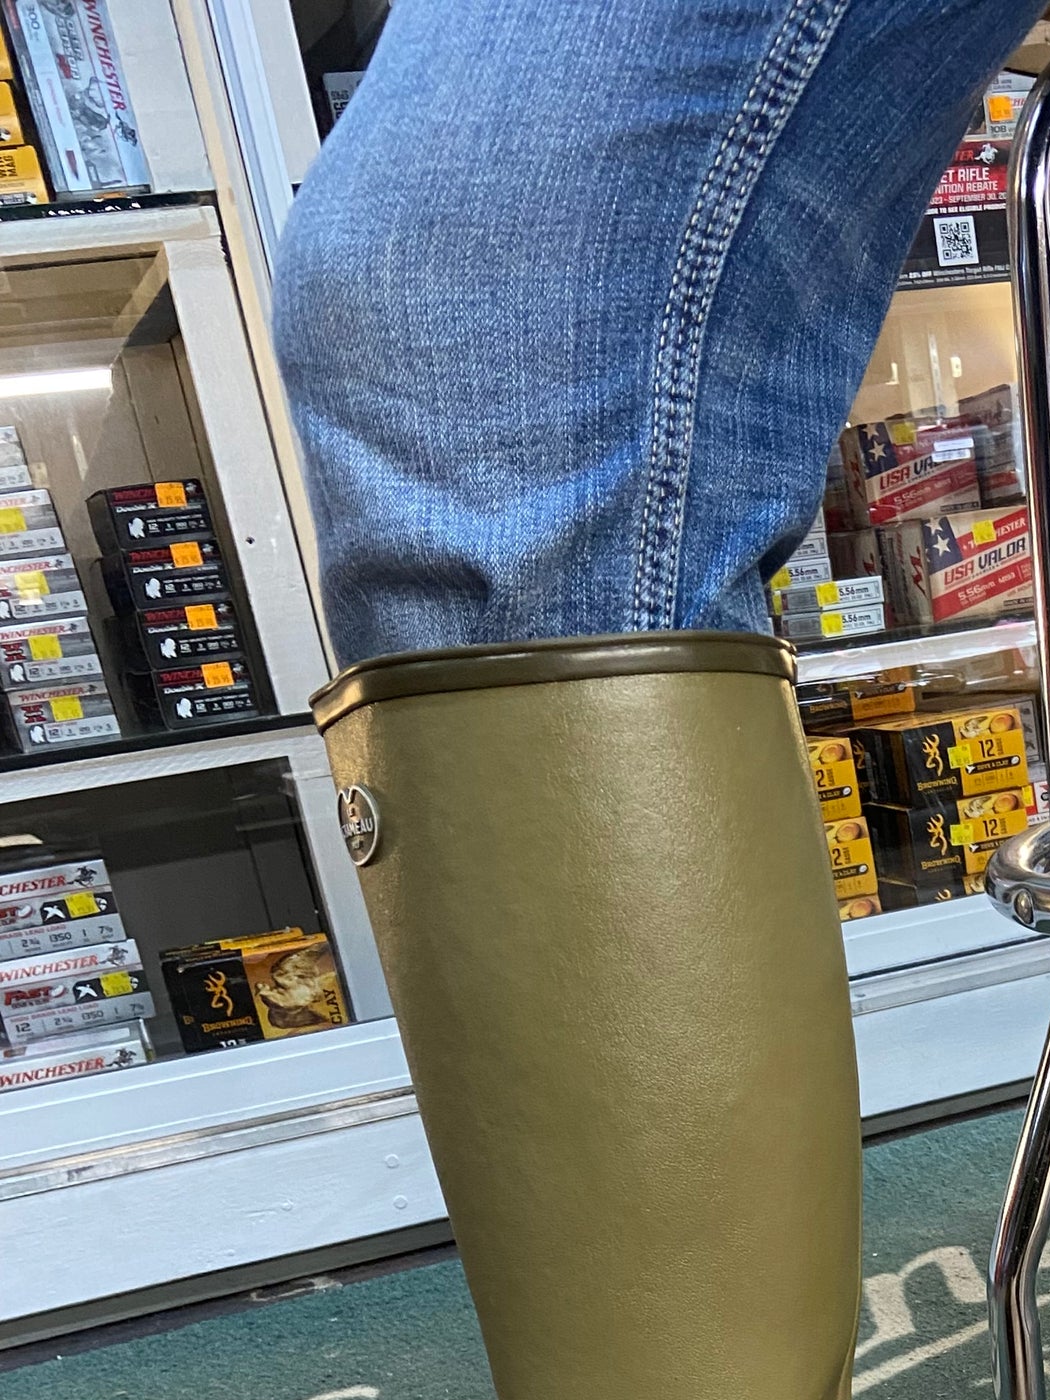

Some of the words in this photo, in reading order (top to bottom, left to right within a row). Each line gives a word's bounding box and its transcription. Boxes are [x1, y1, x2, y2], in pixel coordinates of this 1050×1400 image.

[82, 0, 126, 109] WINCHESTER
[957, 167, 990, 182] RIFLE
[935, 183, 964, 195] NITION
[966, 180, 999, 192] REBATE
[948, 193, 986, 203] SEPTEMBER
[880, 466, 911, 490] USA
[0, 561, 51, 575] NCHESTER
[944, 560, 975, 586] USA
[978, 537, 1026, 570] VALOR
[0, 625, 66, 640] WINCHESTER
[18, 686, 85, 702] WINCHESTER
[978, 738, 995, 758] 12
[815, 769, 825, 788] 2
[917, 776, 958, 791] BROWNING
[983, 818, 999, 838] 12
[920, 855, 961, 871] BROWNING
[0, 875, 67, 897] CHESTER
[0, 955, 99, 982] WINCHESTER
[324, 988, 343, 1024] CLAY
[15, 1022, 31, 1033] 12
[201, 1016, 255, 1033] BROWNING
[0, 1056, 105, 1087] WINCHESTER
